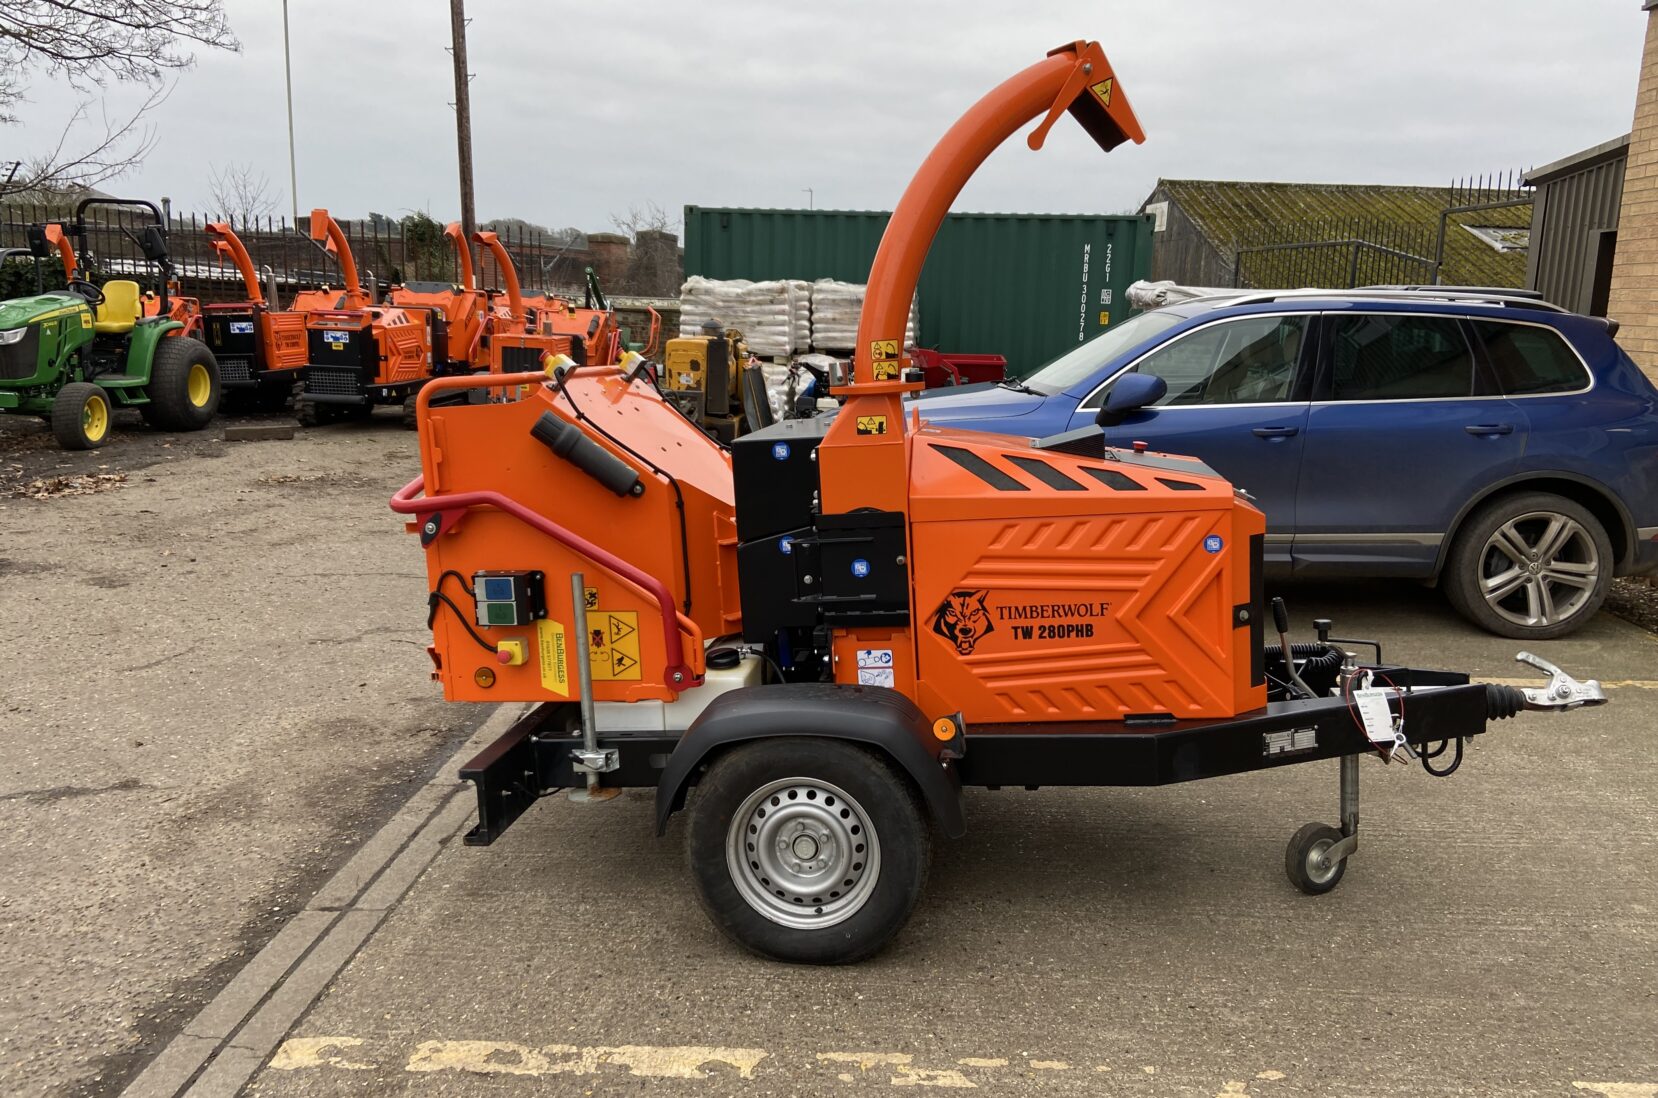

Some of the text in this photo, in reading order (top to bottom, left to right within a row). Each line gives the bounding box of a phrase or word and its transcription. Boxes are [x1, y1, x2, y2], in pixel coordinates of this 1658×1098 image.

[1078, 243, 1091, 341] MRBU 300278
[996, 603, 1110, 620] TIMBERWOLF
[1011, 623, 1094, 640] TW 280PHB
